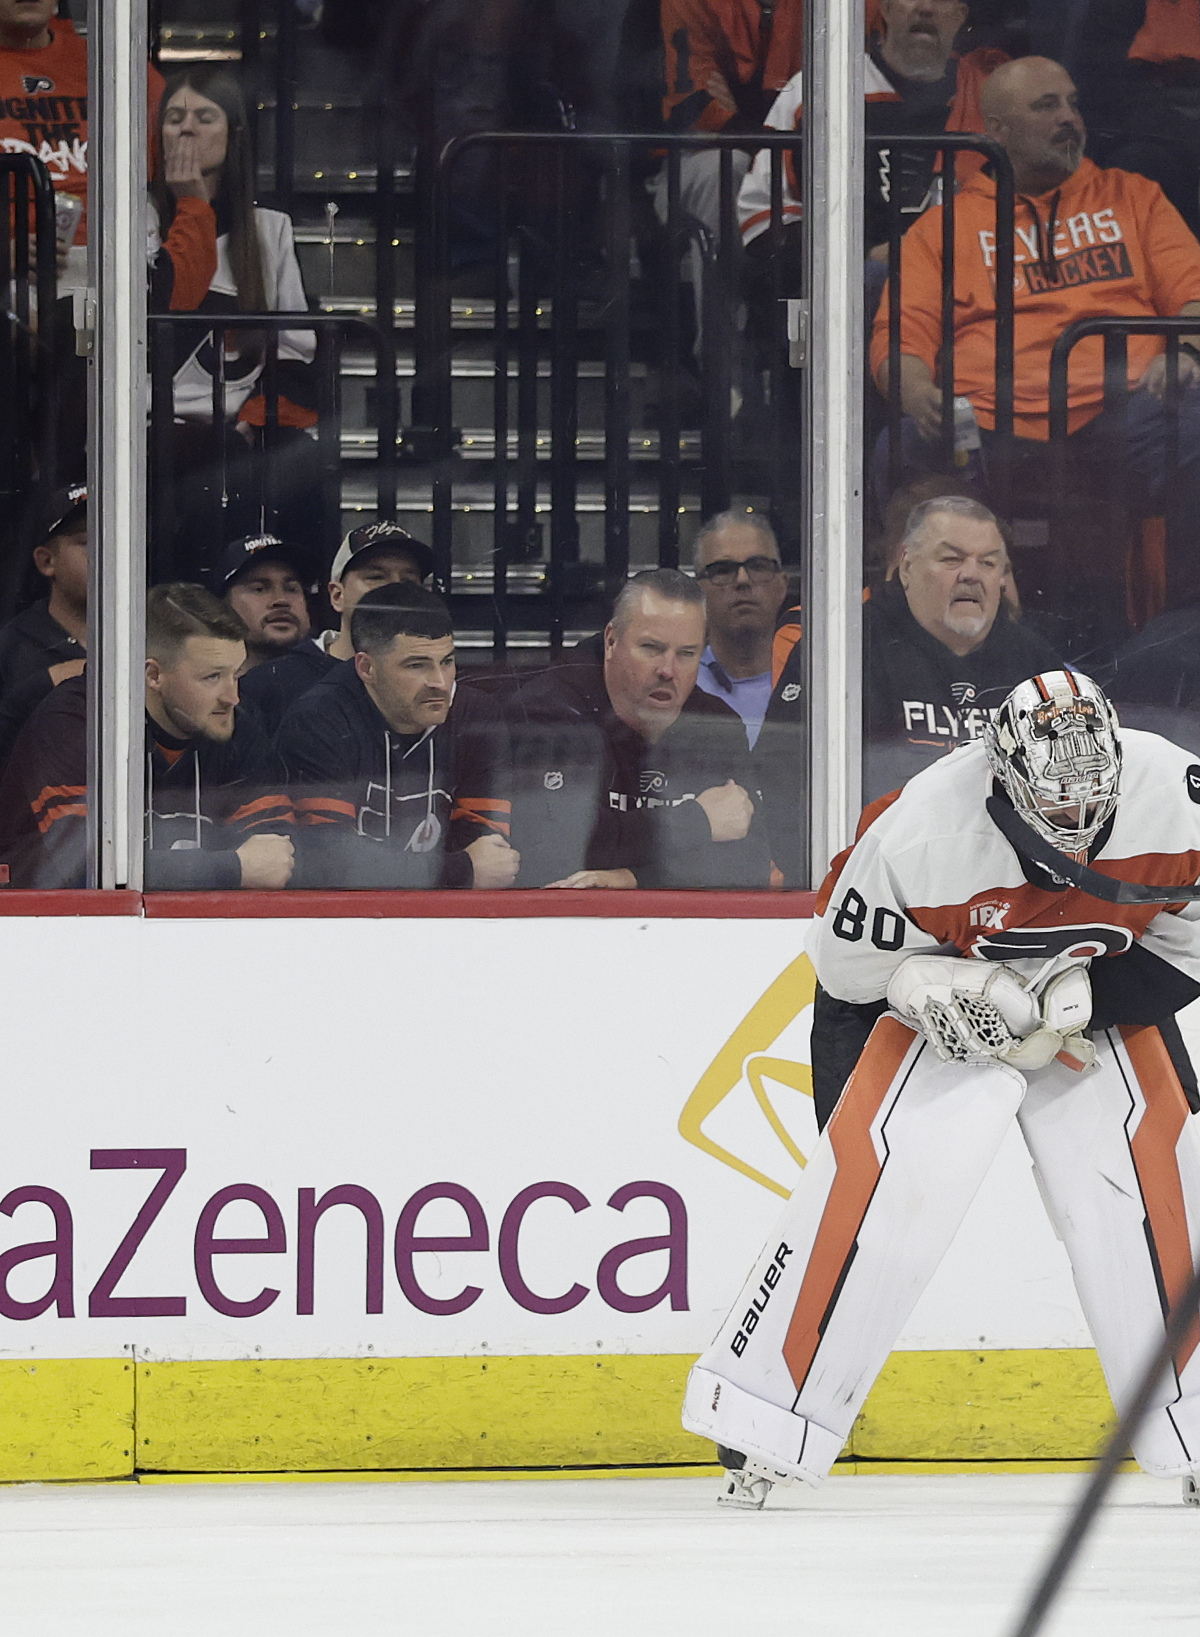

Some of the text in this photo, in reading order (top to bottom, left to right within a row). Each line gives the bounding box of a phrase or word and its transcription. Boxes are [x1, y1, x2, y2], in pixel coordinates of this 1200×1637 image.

[978, 207, 1123, 267] FYERS
[902, 699, 1001, 741] FLYE
[832, 887, 906, 952] 80
[0, 1147, 692, 1321] aZeneca
